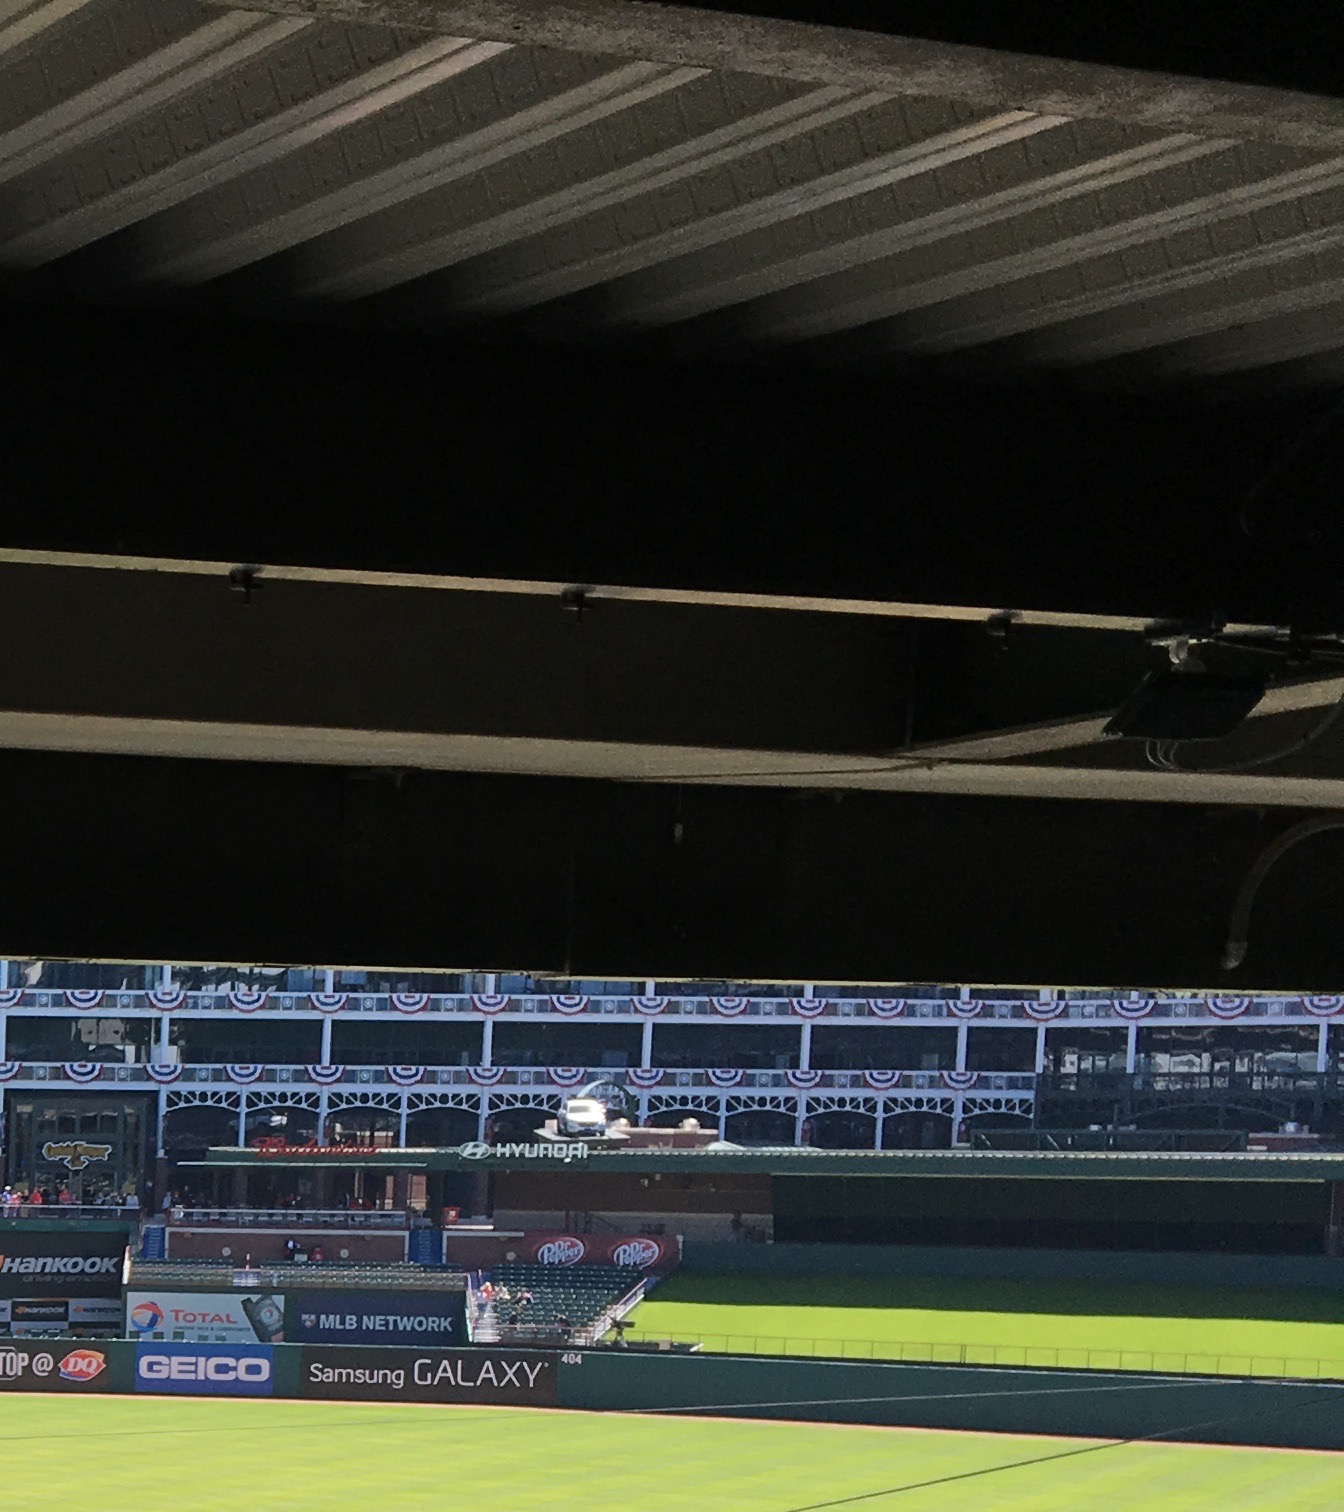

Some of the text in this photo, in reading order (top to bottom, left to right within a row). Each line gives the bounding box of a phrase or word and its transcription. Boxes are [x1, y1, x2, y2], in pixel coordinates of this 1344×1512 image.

[496, 1143, 588, 1159] HYUNDAI
[543, 1244, 581, 1266] Pepper
[618, 1246, 656, 1267] Pepper
[319, 1314, 453, 1333] MLB NETWORK
[33, 1353, 53, 1376] @
[66, 1355, 99, 1373] DQ
[138, 1354, 271, 1382] GEICO
[562, 1353, 582, 1365] 404
[310, 1358, 543, 1389] Samsung GALAXY
